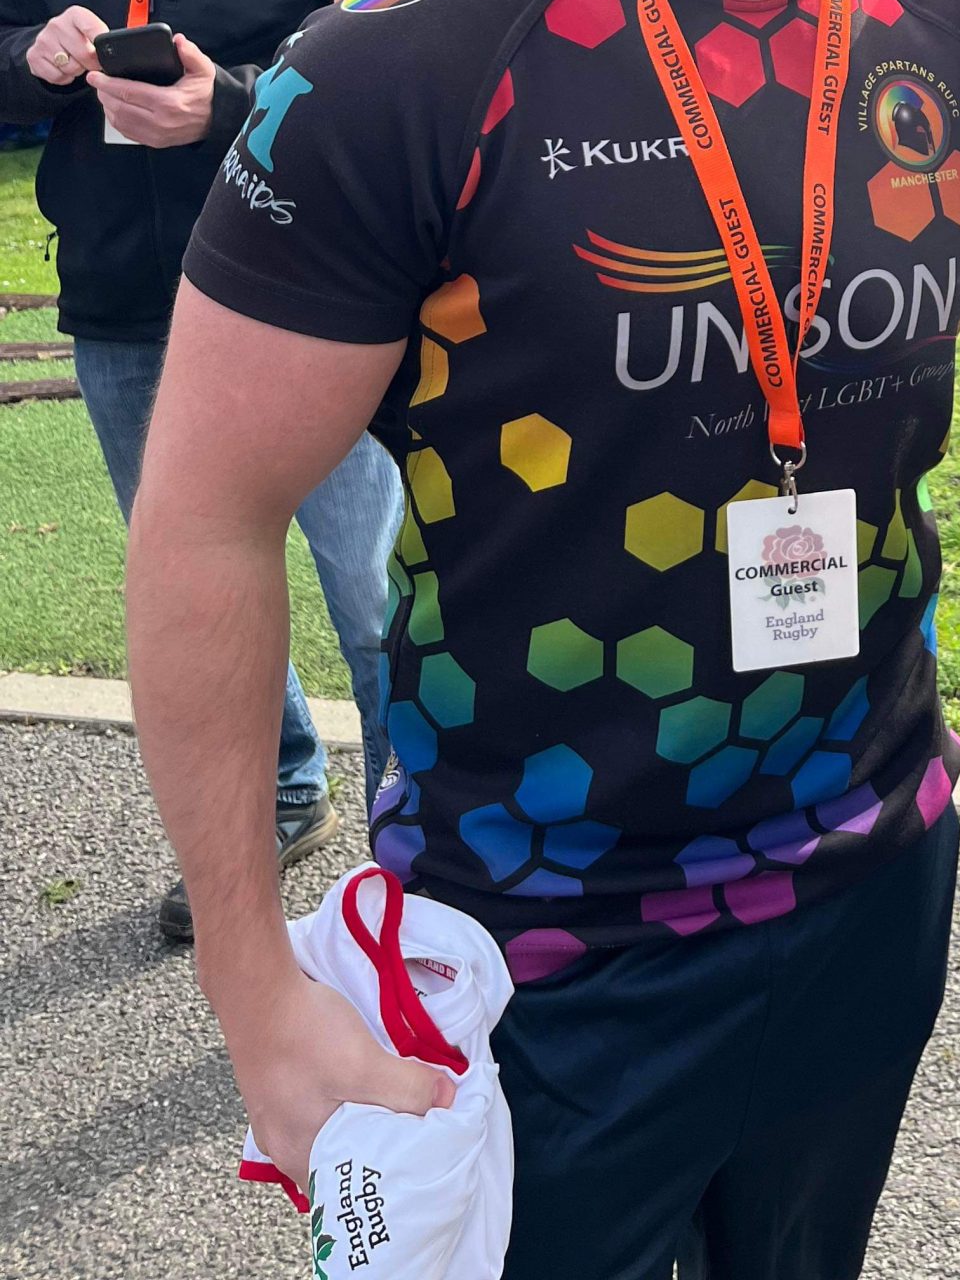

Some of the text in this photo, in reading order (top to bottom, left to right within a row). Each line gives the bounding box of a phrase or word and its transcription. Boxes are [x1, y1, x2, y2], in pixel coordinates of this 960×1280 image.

[654, 24, 713, 150] COMMERCIAL
[818, 75, 839, 136] GUEST
[858, 60, 960, 132] VILLAGE SPARTANS RUFC
[581, 136, 690, 167] KUKR
[890, 168, 959, 189] MANCHESTER
[805, 183, 827, 313] COMMERCIAL
[718, 197, 783, 388] COMMERCIAL GUEST
[614, 257, 957, 391] UNSON
[817, 373, 904, 410] LGBT+
[684, 402, 755, 439] North
[735, 555, 848, 581] COMMERCIAL
[770, 580, 818, 597] Guest
[765, 609, 825, 629] England
[773, 625, 818, 641] Rugby
[335, 1158, 370, 1271] England
[354, 1166, 390, 1250] Rugby
